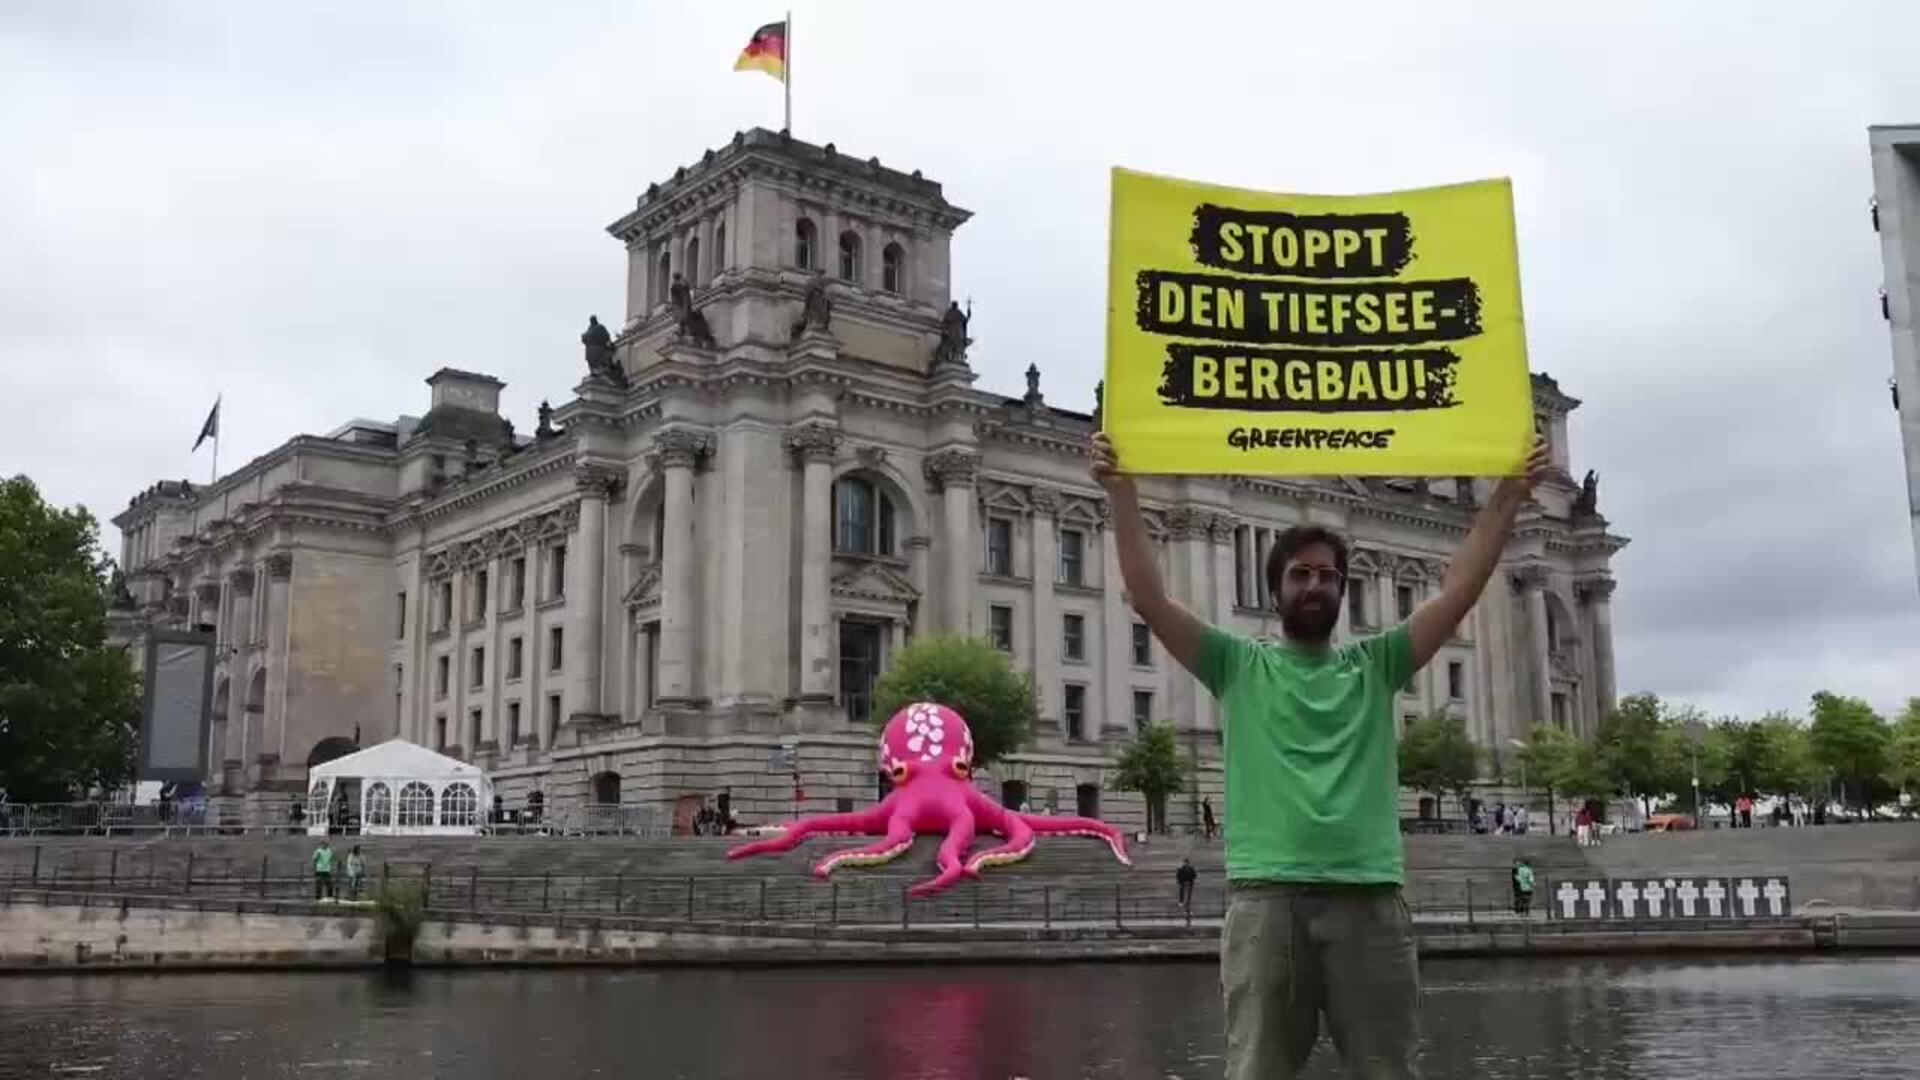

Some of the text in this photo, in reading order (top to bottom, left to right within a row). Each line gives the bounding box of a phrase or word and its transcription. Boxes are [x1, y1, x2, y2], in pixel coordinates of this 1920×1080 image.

[1219, 222, 1388, 267] STOPPT
[1159, 282, 1456, 335] DEN TIEFSEE-
[1193, 355, 1427, 401] BERGBAU!
[1228, 428, 1395, 449] GREENPEACE
